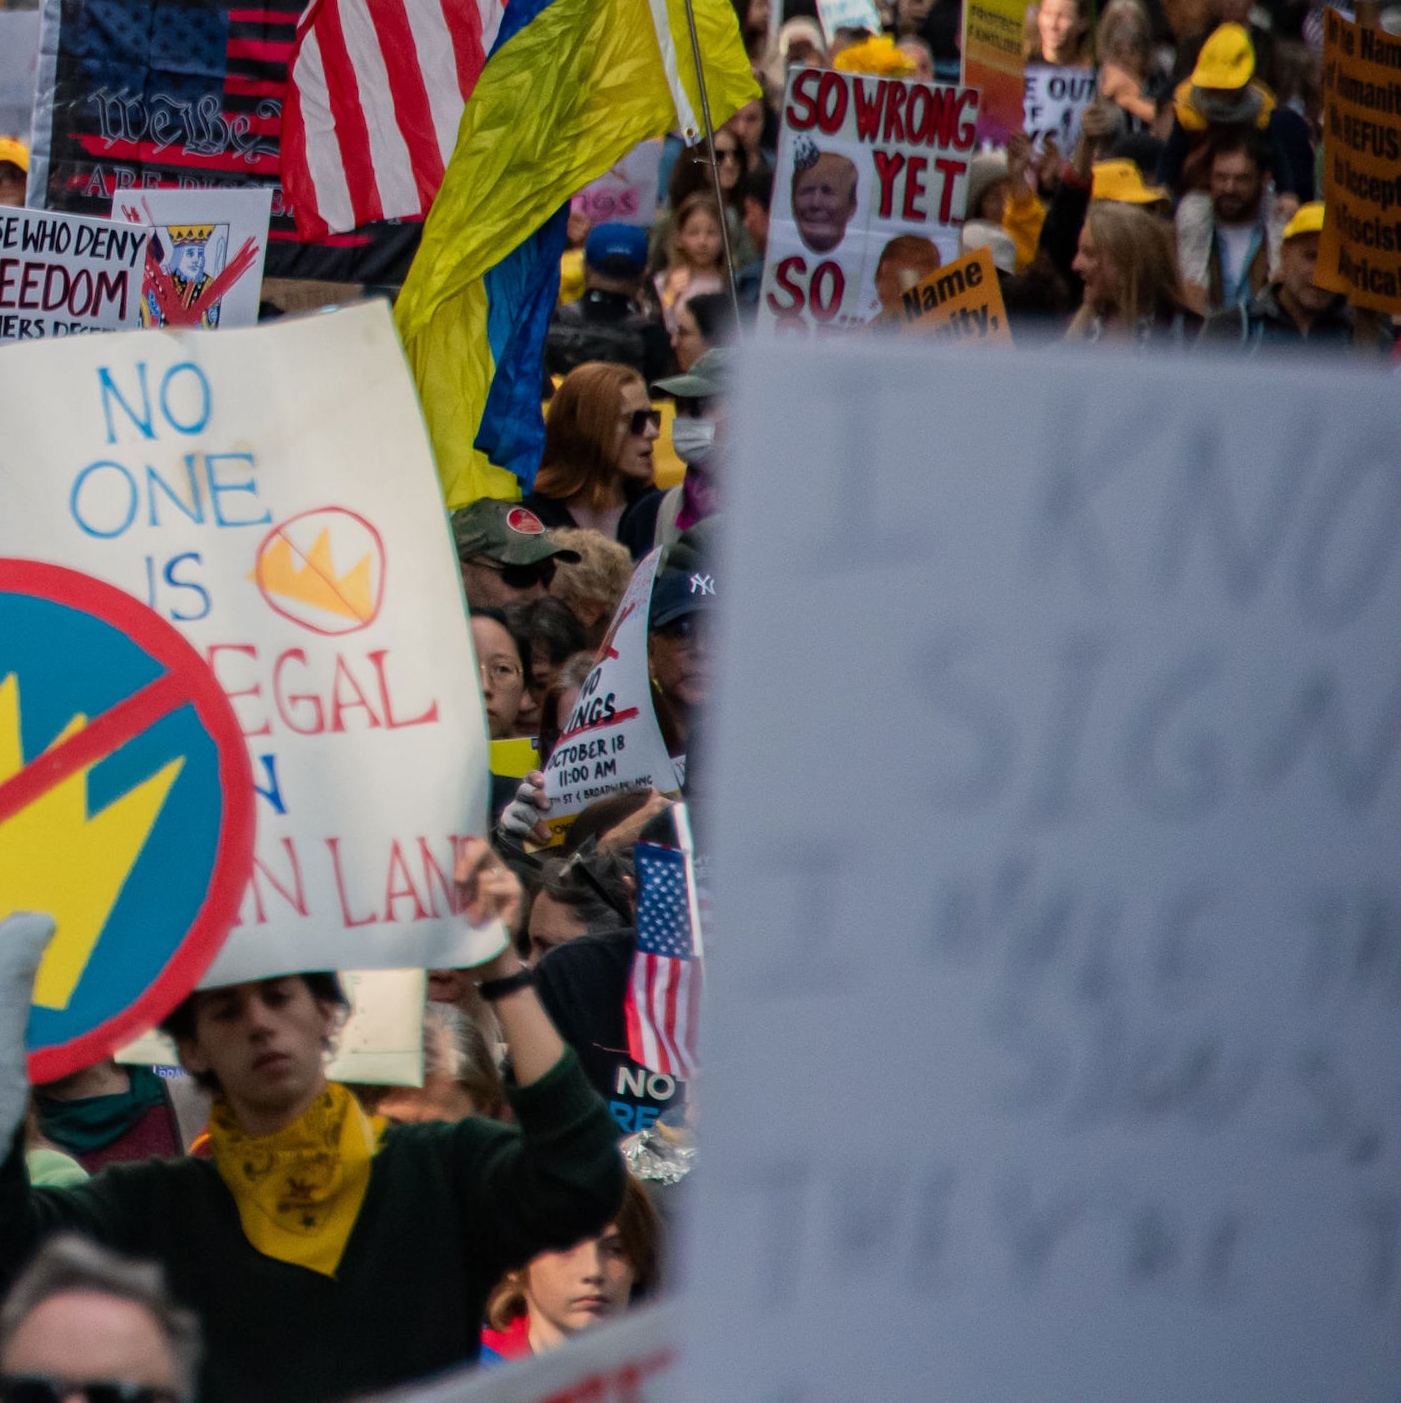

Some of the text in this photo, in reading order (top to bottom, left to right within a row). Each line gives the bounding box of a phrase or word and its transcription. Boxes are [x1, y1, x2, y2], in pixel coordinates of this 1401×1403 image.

[1360, 27, 1401, 70] Nam
[786, 70, 980, 152] SO WRONG
[23, 217, 70, 253] WHO
[76, 222, 146, 268] DENY
[901, 260, 983, 323] Name
[96, 361, 213, 445] NO
[70, 453, 272, 539] ONE
[1020, 385, 1401, 631] KNO
[145, 553, 212, 621] IS
[690, 573, 716, 596] NY
[207, 646, 441, 739] EGAL
[582, 667, 602, 699] NO
[564, 692, 617, 735] INGS
[548, 734, 626, 771] OCTOBER 18
[558, 758, 617, 788] 11:00 AM
[635, 775, 654, 787] NYC
